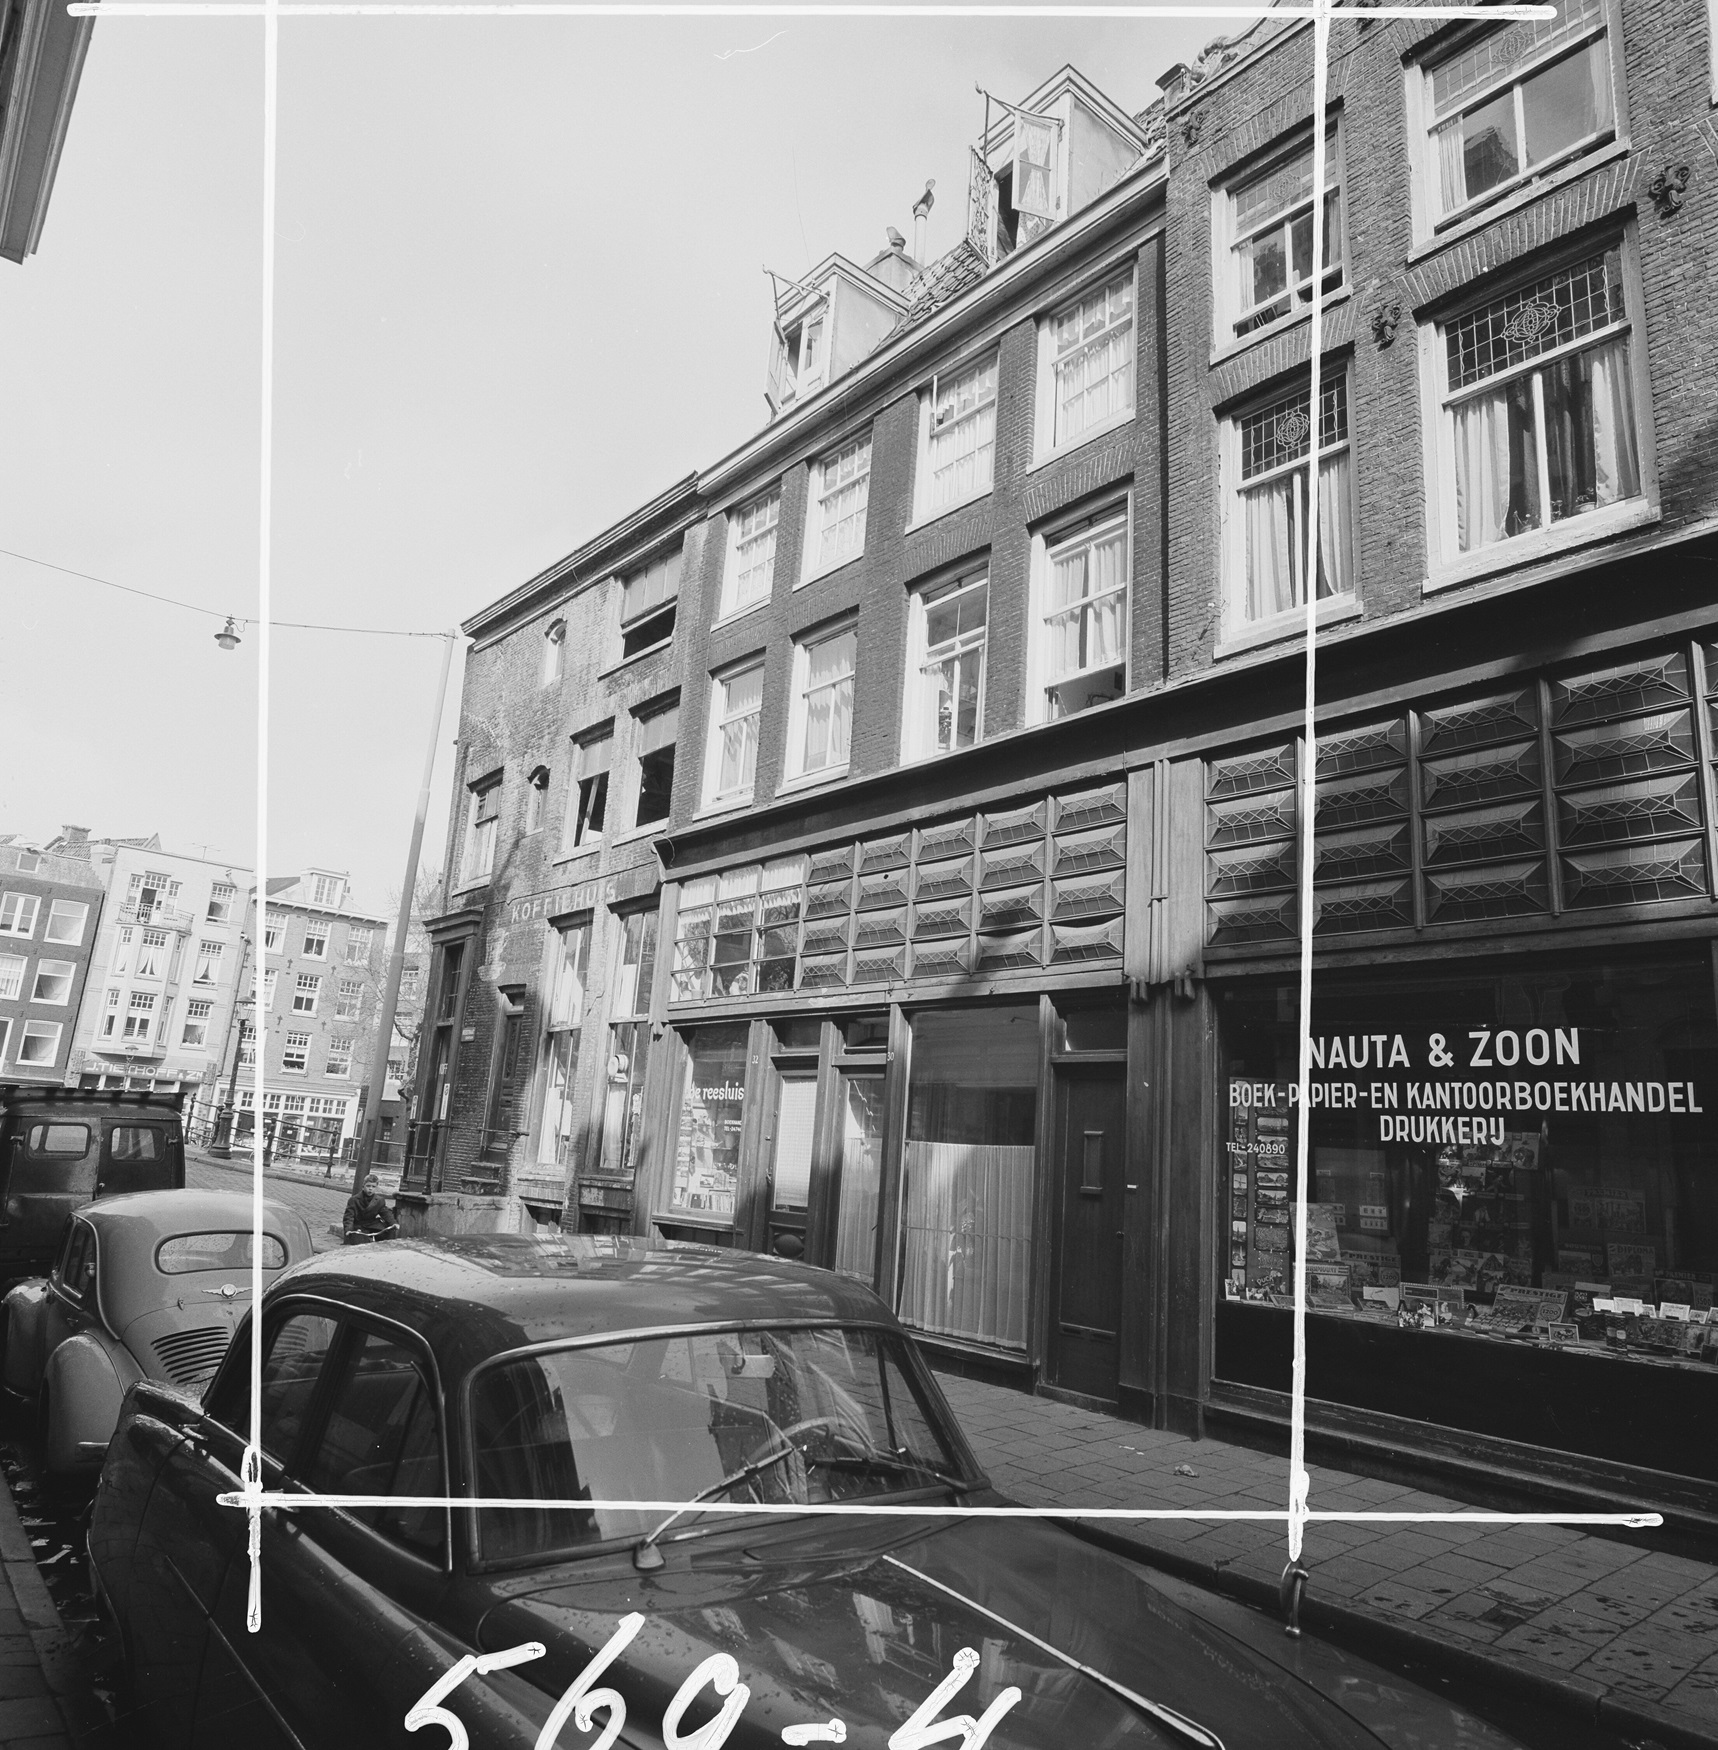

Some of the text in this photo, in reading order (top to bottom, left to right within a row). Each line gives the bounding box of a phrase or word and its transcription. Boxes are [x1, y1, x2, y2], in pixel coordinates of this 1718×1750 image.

[511, 883, 616, 924] KOFFIEHUS
[887, 1051, 895, 1062] 30
[1308, 1028, 1580, 1069] NAUTA & ZOON
[690, 1080, 745, 1101] de reesluis
[1407, 1081, 1703, 1113] KANTOORBOEKHANDEL
[1348, 1252, 1397, 1262] PRESTIGE
[1510, 1287, 1564, 1299] PRESTIGE
[1542, 1308, 1560, 1316] 1200
